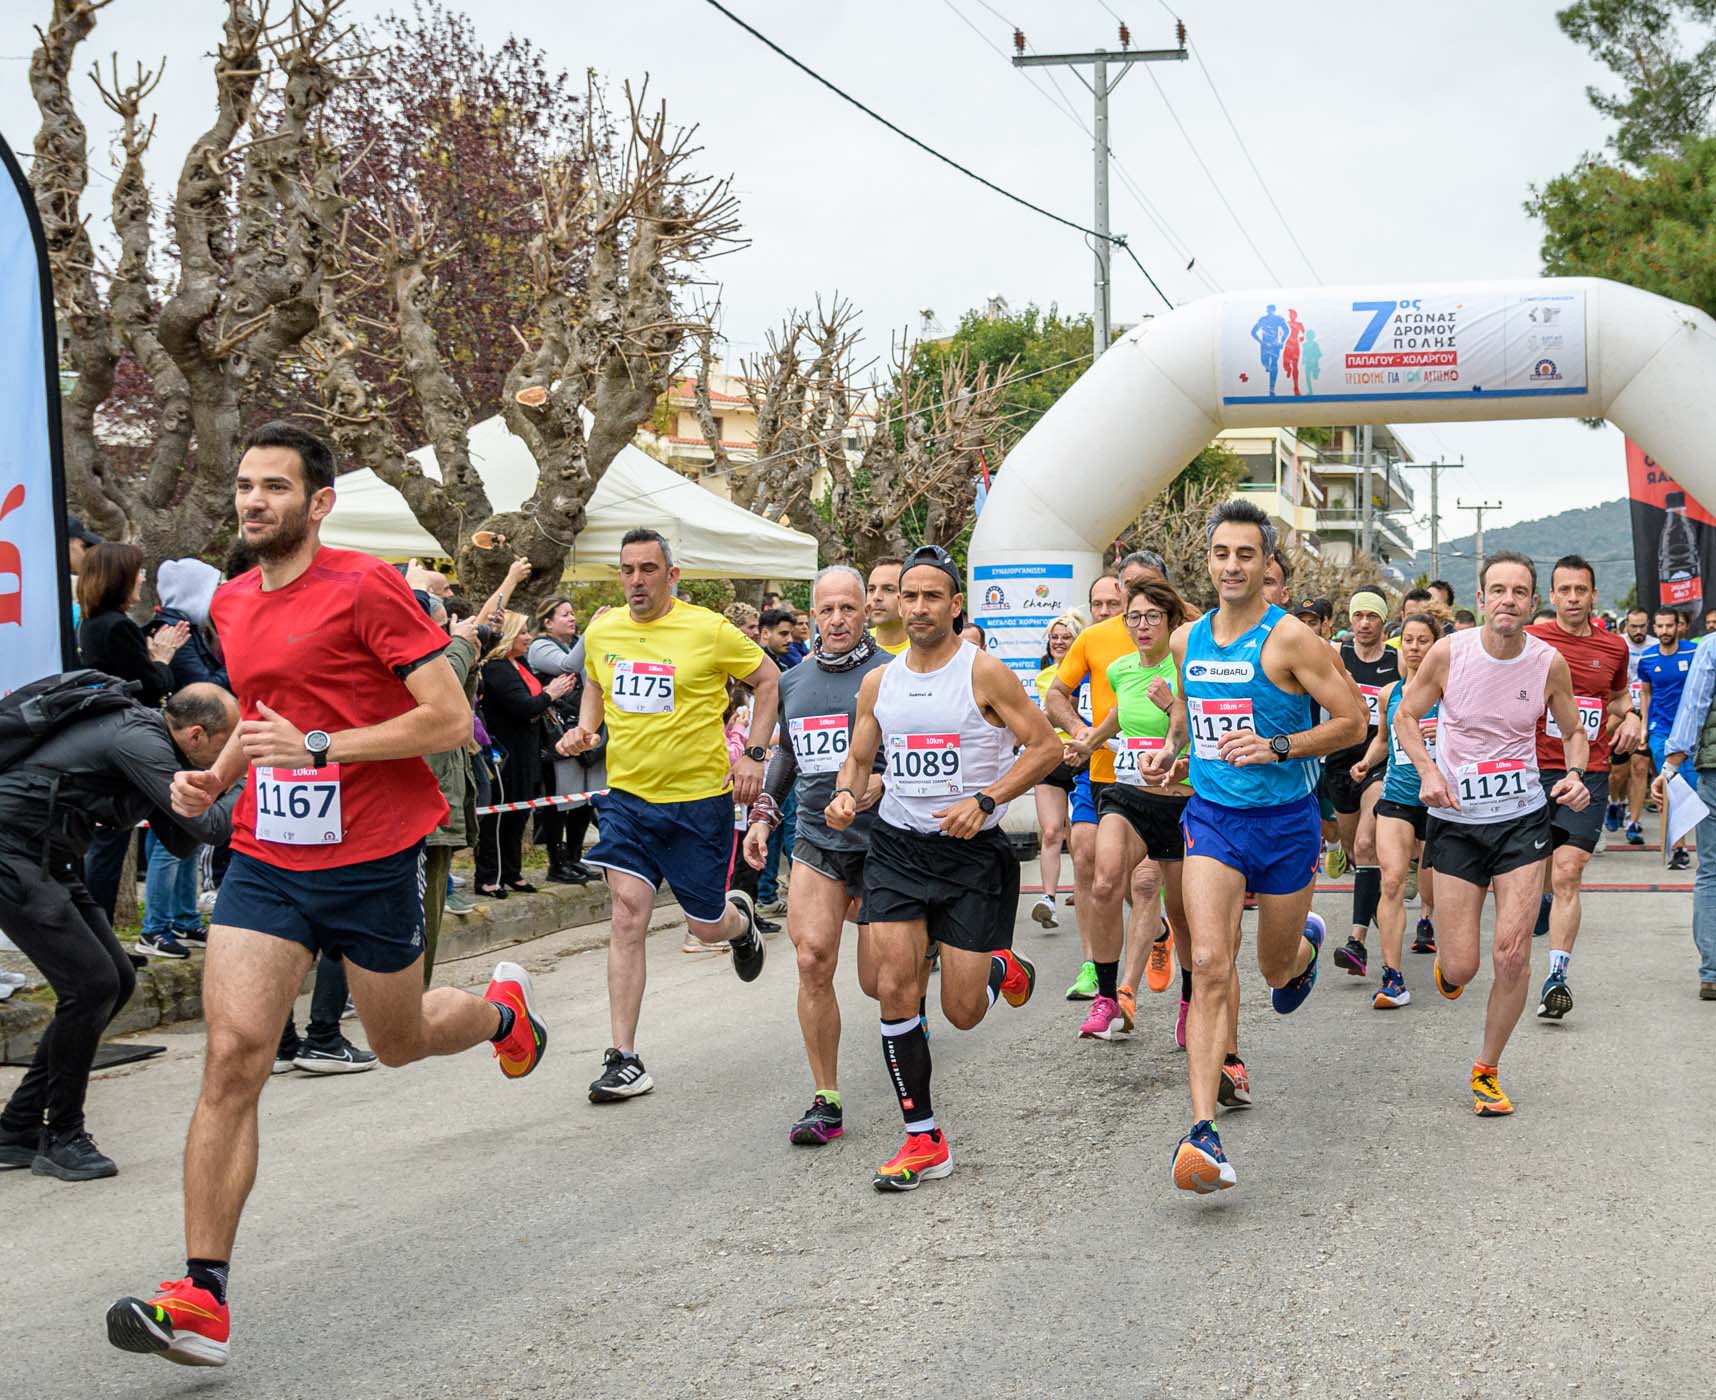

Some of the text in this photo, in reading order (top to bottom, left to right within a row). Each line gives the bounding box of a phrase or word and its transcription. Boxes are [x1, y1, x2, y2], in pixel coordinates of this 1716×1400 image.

[1394, 312, 1456, 323] ΑΓΩΝΑΣ
[1394, 324, 1456, 336] ΔΡΟΜΟΥ
[1394, 336, 1456, 349] ΠΟΛΗΣ
[1347, 356, 1394, 366] ΠΑΠΑΓΟΥ
[1402, 353, 1455, 364] ΧΟΛΑΡΓΟΥ
[1023, 599, 1062, 611] Champs
[1019, 617, 1051, 626] ΧΟΡΗΓΟ
[1210, 668, 1248, 676] SUBARU
[614, 674, 672, 698] 1175
[1219, 703, 1238, 711] 10km
[793, 729, 848, 757] 1126
[926, 737, 944, 745] 10km
[891, 750, 960, 777] 1089
[1495, 761, 1512, 769] 10km
[292, 768, 318, 777] 10km
[1460, 771, 1527, 801] 1121
[258, 781, 337, 819] 1167
[887, 1040, 908, 1097] COMPRESSPORT
